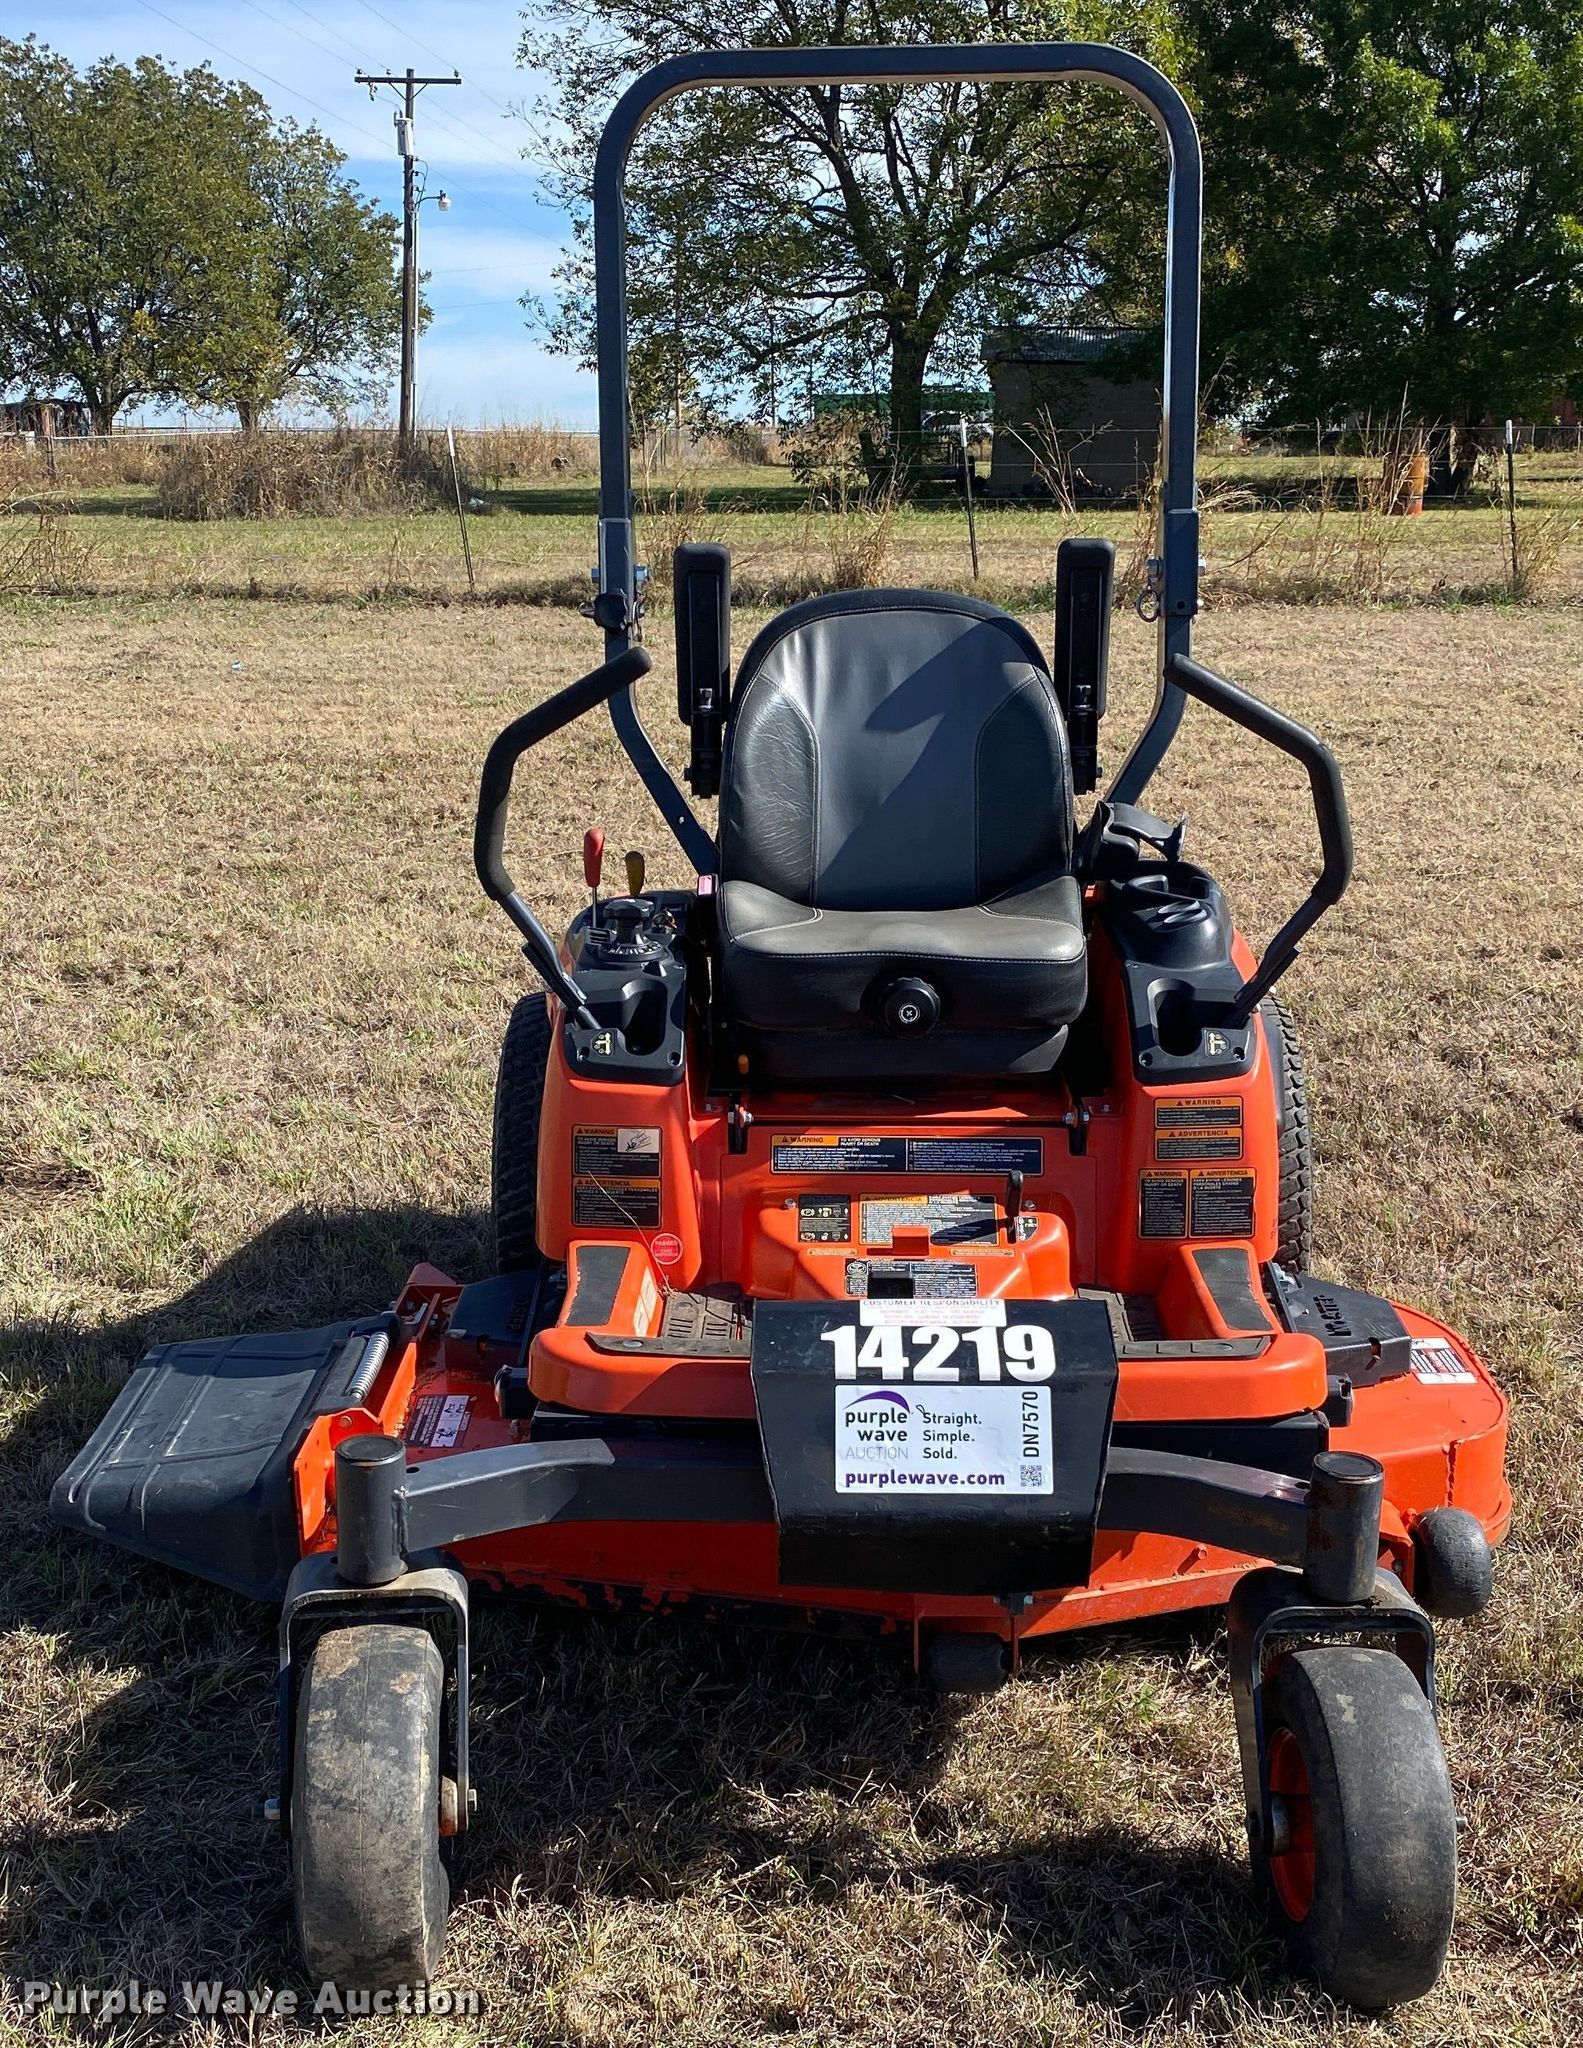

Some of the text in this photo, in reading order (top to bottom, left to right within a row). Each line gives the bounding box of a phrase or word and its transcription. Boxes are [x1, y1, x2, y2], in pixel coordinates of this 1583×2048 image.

[583, 1127, 615, 1136] WARNING
[1177, 1130, 1229, 1138] ADVERTENCIA
[1205, 1169, 1248, 1177] ADVERTENCIA
[820, 1324, 1057, 1383] 14219
[844, 1407, 909, 1428] purple
[922, 1411, 983, 1428] Straight.
[1021, 1390, 1040, 1458] DN7570
[857, 1428, 909, 1442] wave
[922, 1429, 976, 1445] Simple.
[844, 1446, 910, 1461] AUCTION
[922, 1446, 958, 1460] Sold.
[844, 1469, 1006, 1488] purplewave.com
